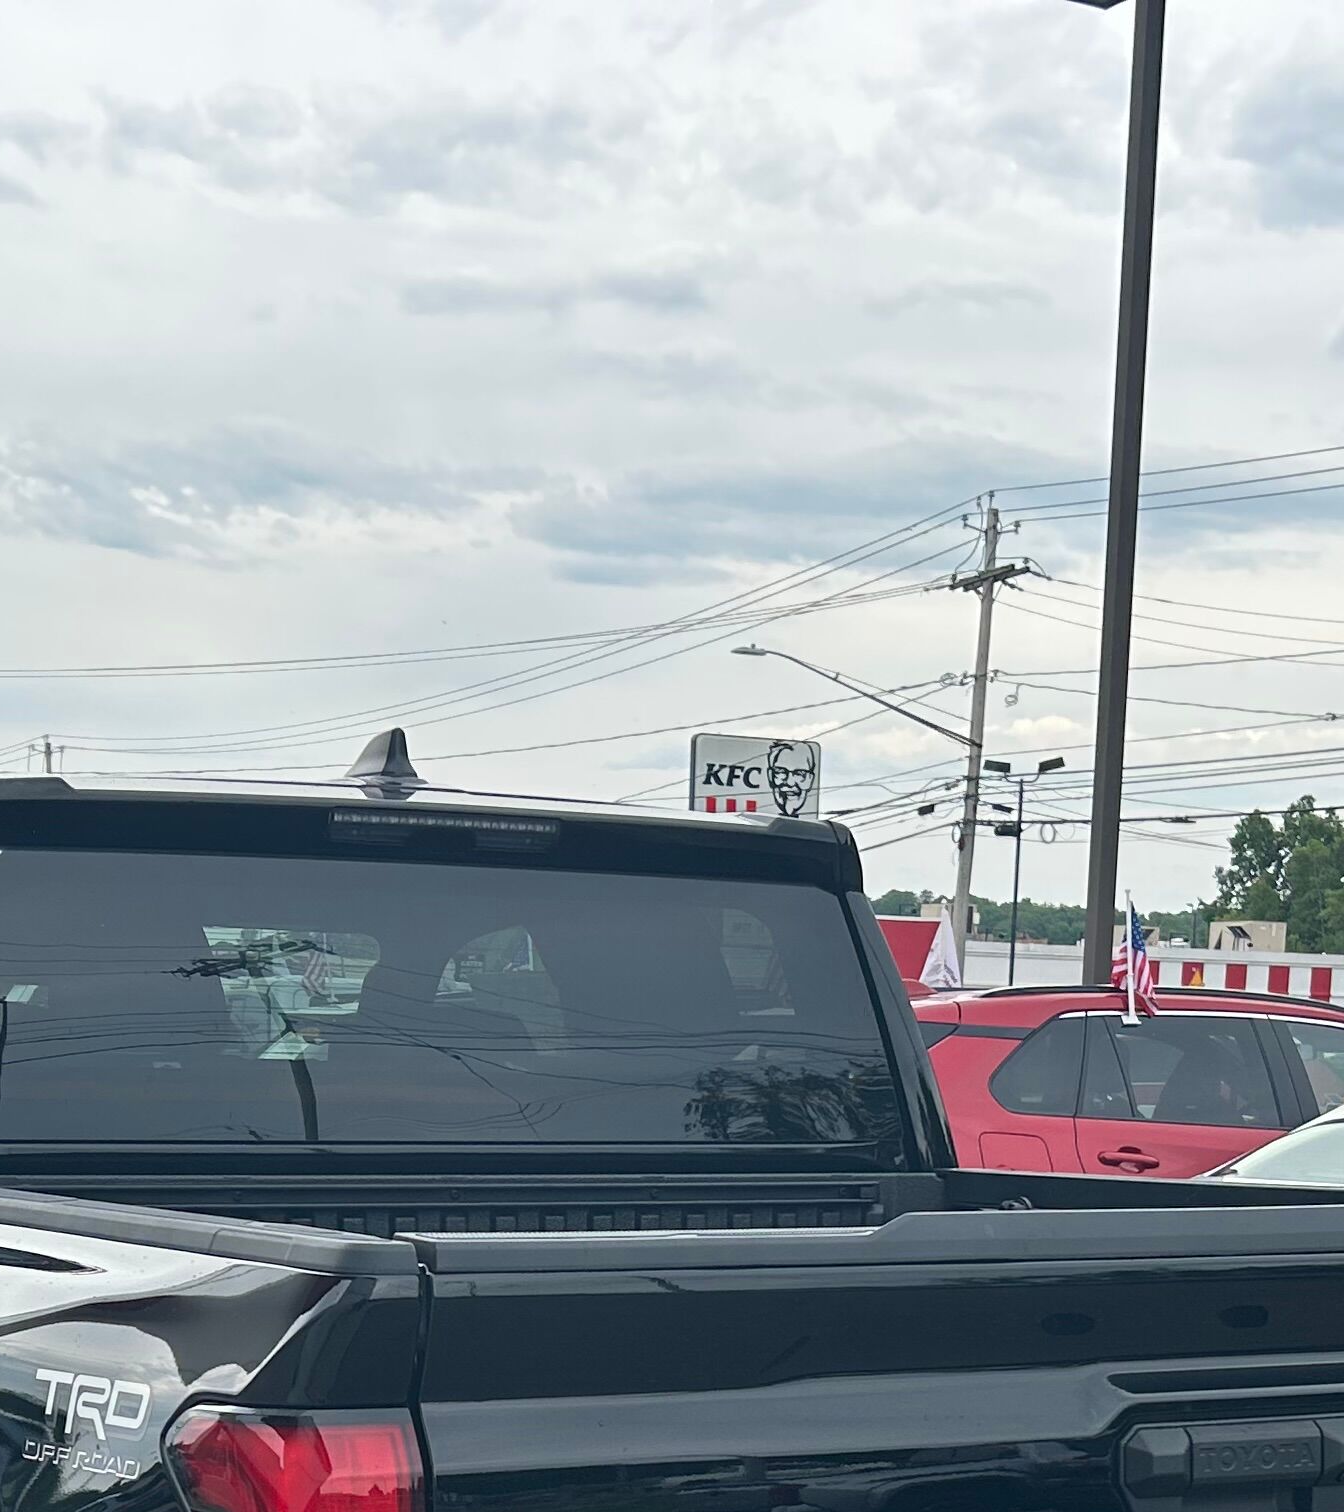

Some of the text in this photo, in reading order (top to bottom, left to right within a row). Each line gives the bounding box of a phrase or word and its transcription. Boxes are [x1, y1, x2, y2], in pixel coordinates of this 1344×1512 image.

[702, 763, 762, 788] KFC
[35, 1368, 152, 1440] TRD
[22, 1438, 72, 1465] OFF
[1199, 1442, 1317, 1474] TOYOTA
